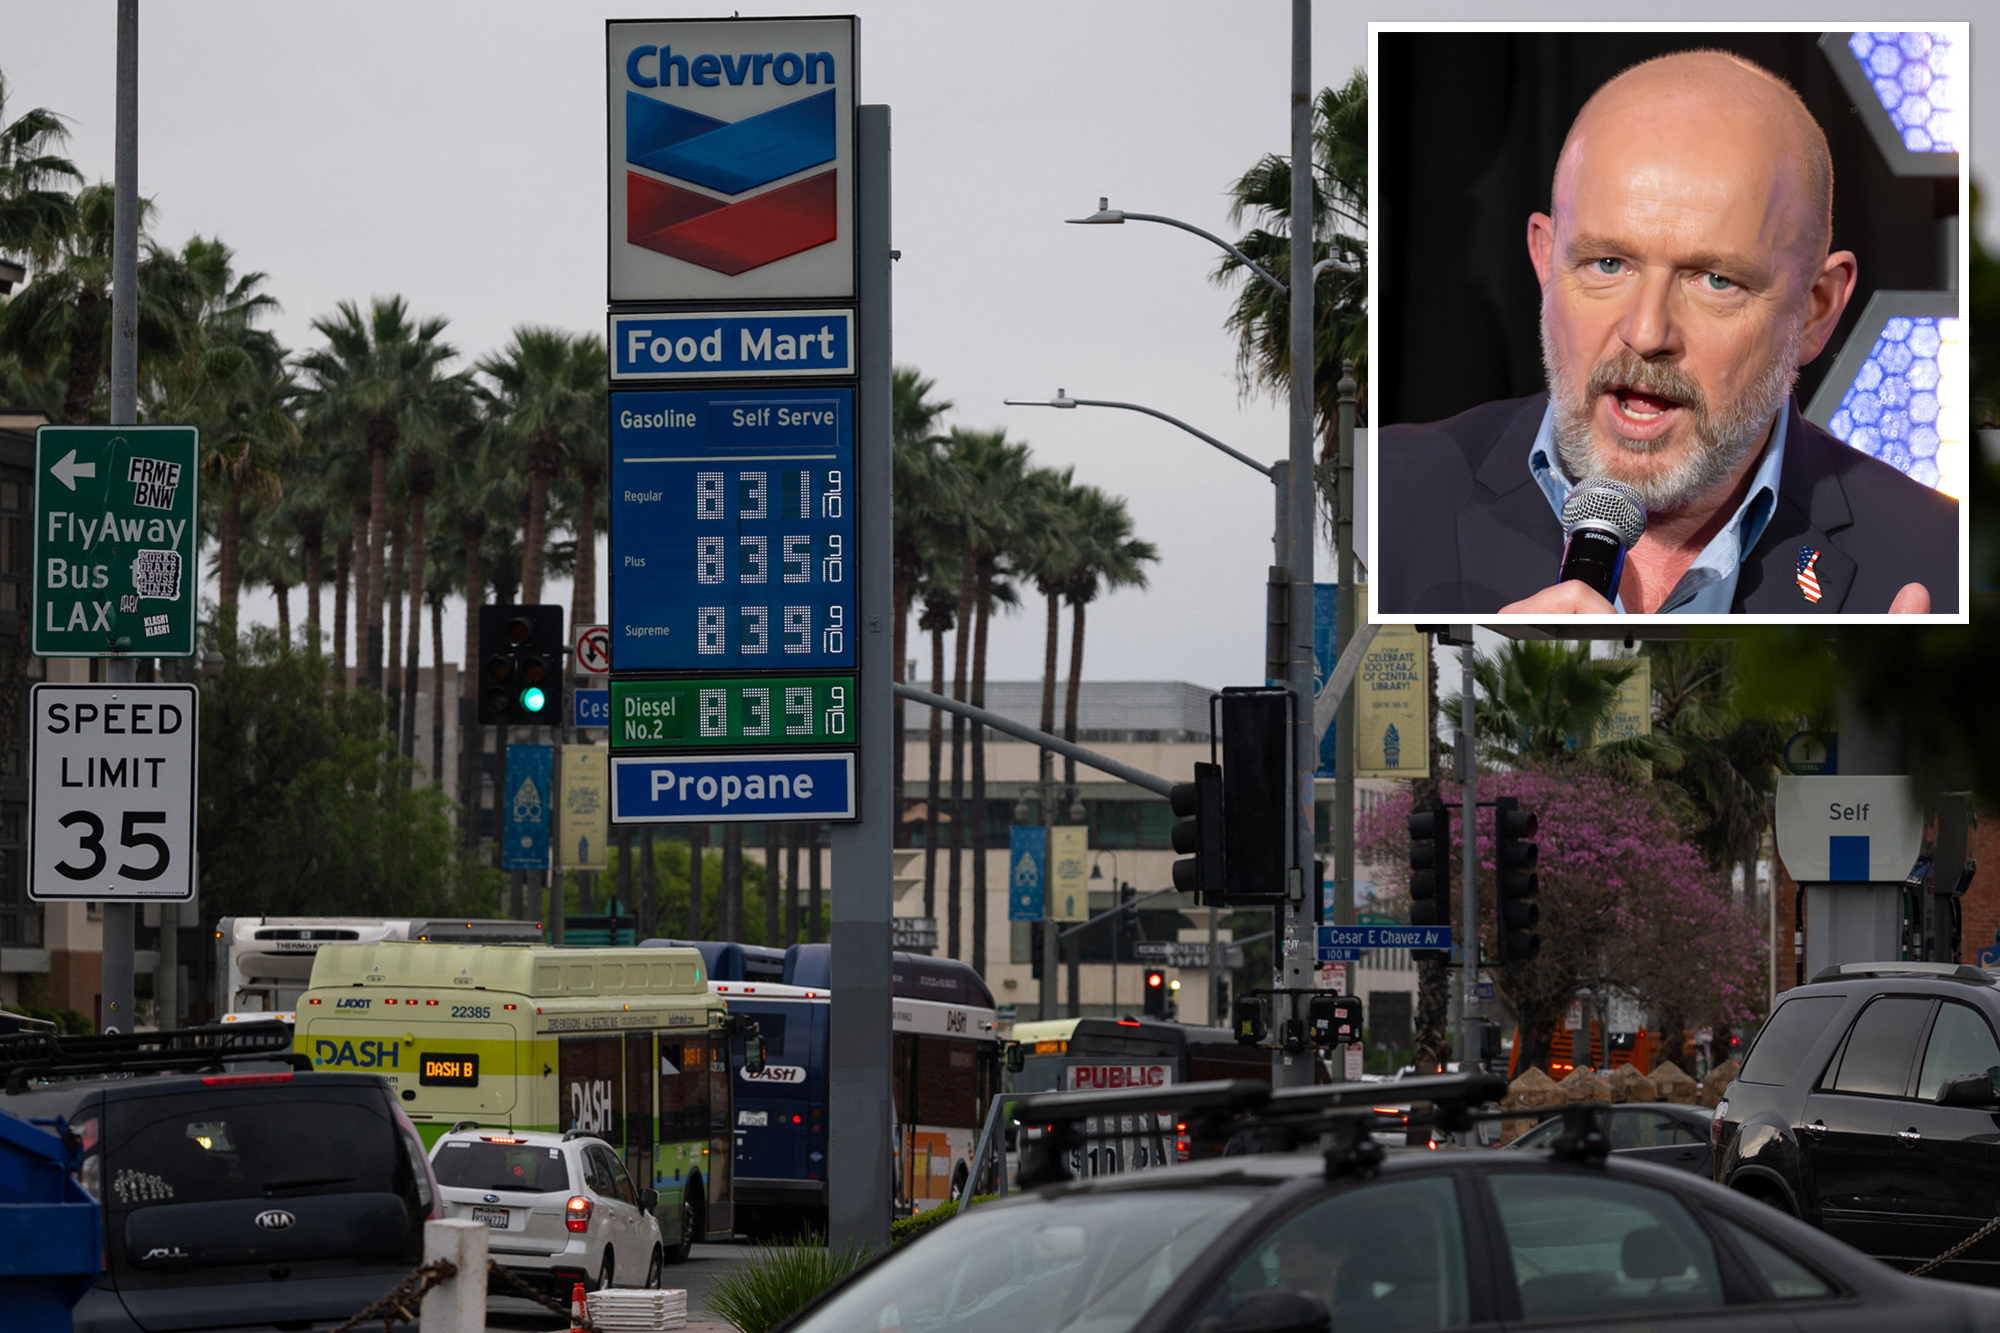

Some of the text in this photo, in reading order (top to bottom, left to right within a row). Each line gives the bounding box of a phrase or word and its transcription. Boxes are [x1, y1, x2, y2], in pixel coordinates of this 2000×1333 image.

[626, 44, 835, 88] Chevron
[628, 325, 834, 363] Food Mart
[620, 408, 835, 429] Gasoline Self Serve
[130, 458, 179, 486] FRME
[136, 482, 174, 509] BNW
[624, 490, 663, 503] Regular
[48, 512, 186, 550] FlyAway
[1584, 532, 1615, 546] SHURE
[140, 563, 177, 573] DRAKE
[625, 555, 646, 567] Plus
[48, 559, 109, 588] Bus
[46, 602, 111, 632] LAX
[625, 624, 670, 637] Supreme
[1364, 662, 1417, 671] 100 YEARS
[1367, 653, 1414, 662] CELEBRATE
[1363, 672, 1419, 681] OF CENTRAL
[1372, 682, 1410, 691] LIBRARY!
[625, 696, 676, 717] Diesel
[47, 703, 183, 735] SPEED
[625, 720, 663, 740] No.2
[62, 758, 166, 788] LIMIT
[651, 770, 814, 808] Propane
[1828, 801, 1870, 822] Self
[54, 810, 170, 881] 35
[1331, 929, 1439, 945] Cesar E Chavez Av
[1326, 949, 1352, 960] 100 W
[336, 998, 372, 1009] LADOT
[451, 1006, 491, 1018] 22385
[947, 1010, 968, 1034] DASH
[316, 1040, 399, 1068] DASH
[426, 1061, 473, 1078] DASH B
[1075, 1065, 1164, 1088] PUBLIC
[571, 1079, 612, 1134] DASH
[261, 1214, 290, 1227] KIA
